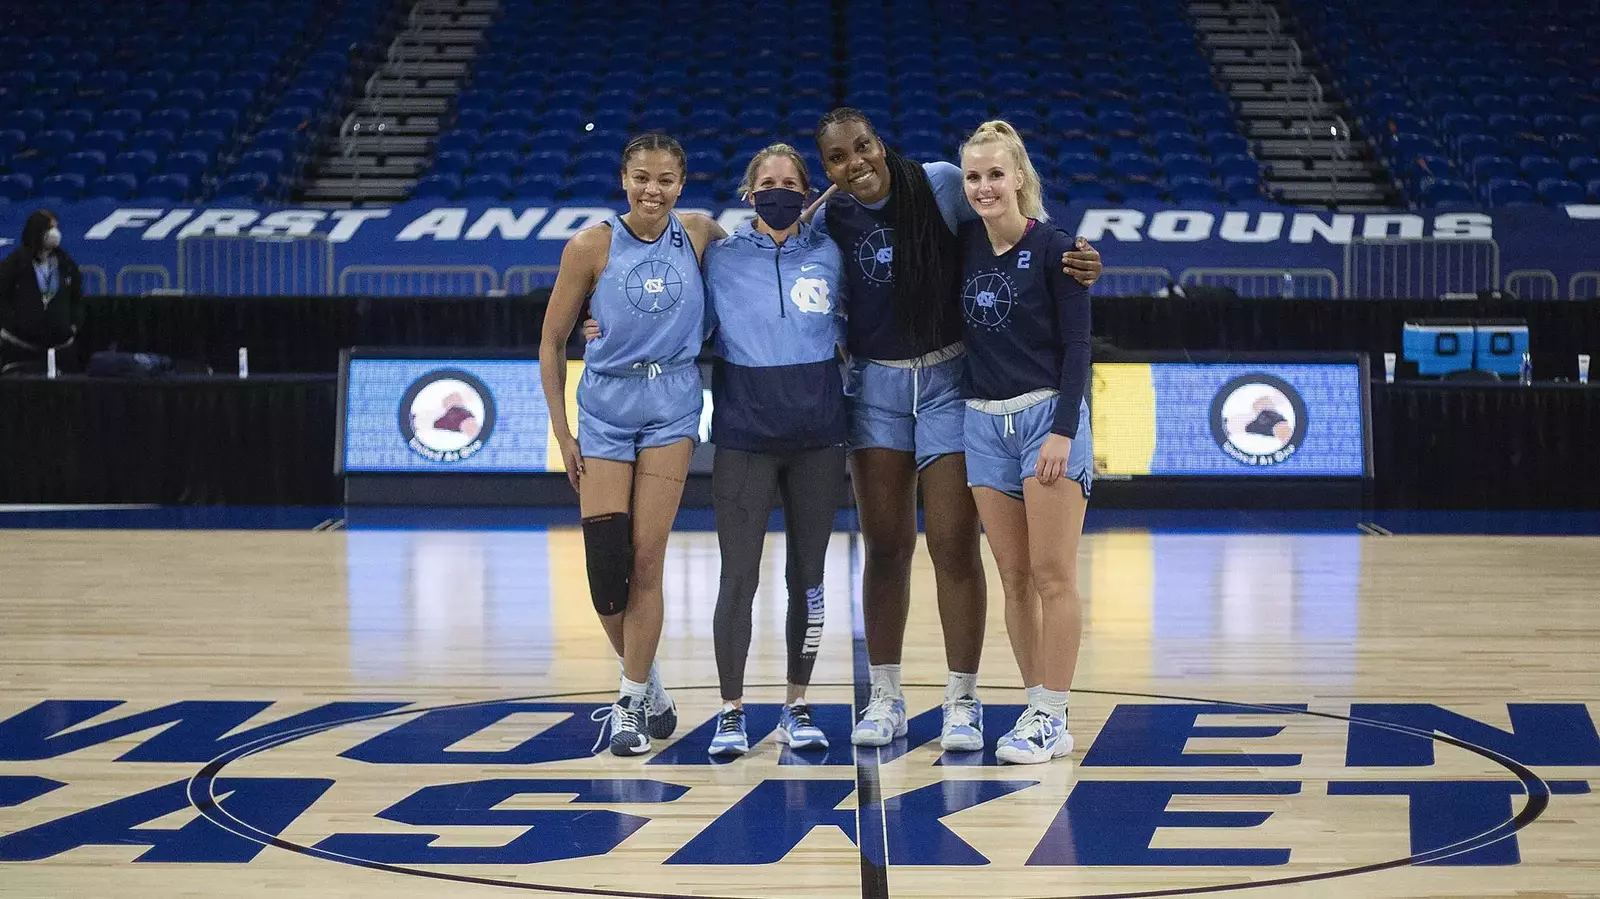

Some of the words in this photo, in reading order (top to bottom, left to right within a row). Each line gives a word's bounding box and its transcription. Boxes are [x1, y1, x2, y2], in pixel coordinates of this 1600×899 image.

[84, 209, 391, 242] FIRST
[395, 207, 616, 241] AND
[1076, 208, 1493, 243] ROUNDS
[1017, 250, 1032, 269] 2
[0, 775, 1592, 866] ASKET
